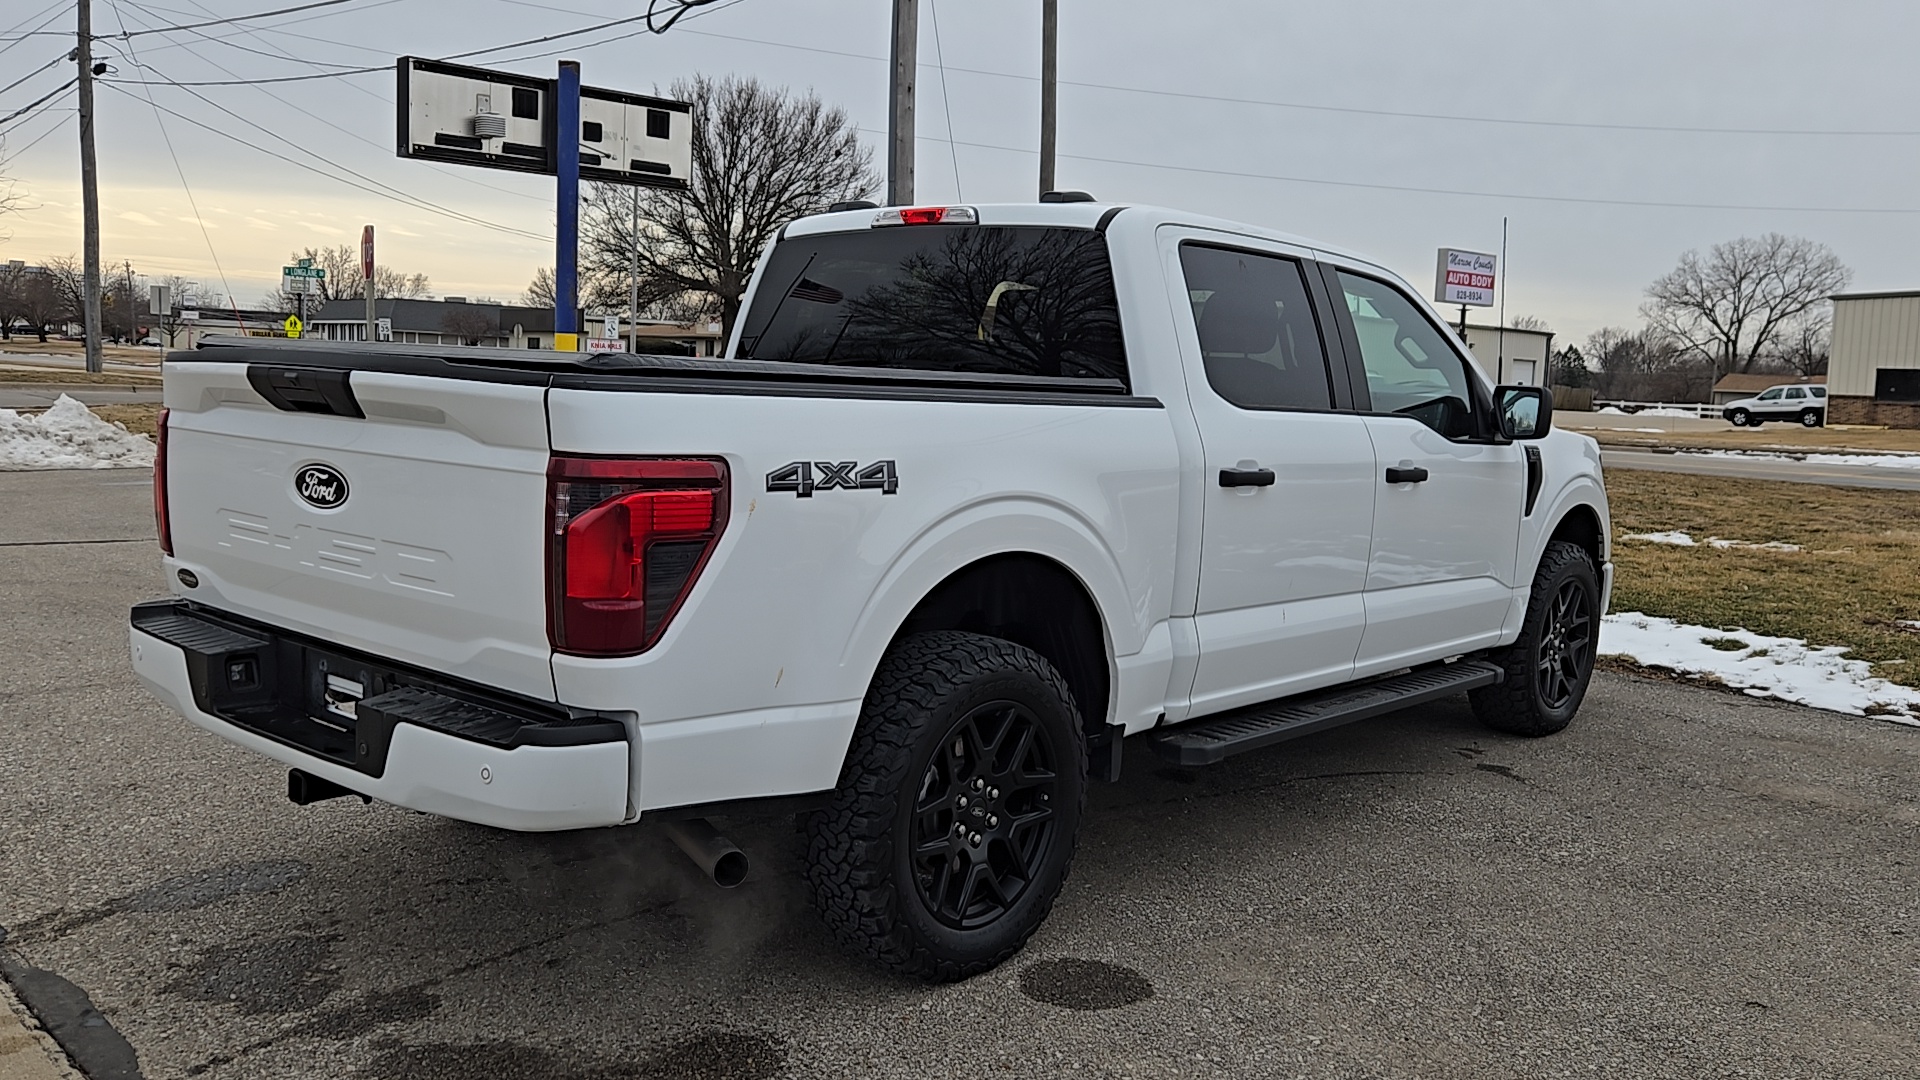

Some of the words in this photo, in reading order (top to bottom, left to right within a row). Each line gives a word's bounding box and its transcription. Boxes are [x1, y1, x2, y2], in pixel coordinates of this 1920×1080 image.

[1473, 255, 1494, 273] County
[1447, 271, 1470, 285] AUTO
[1470, 274, 1493, 288] BODY
[302, 470, 338, 502] Ford
